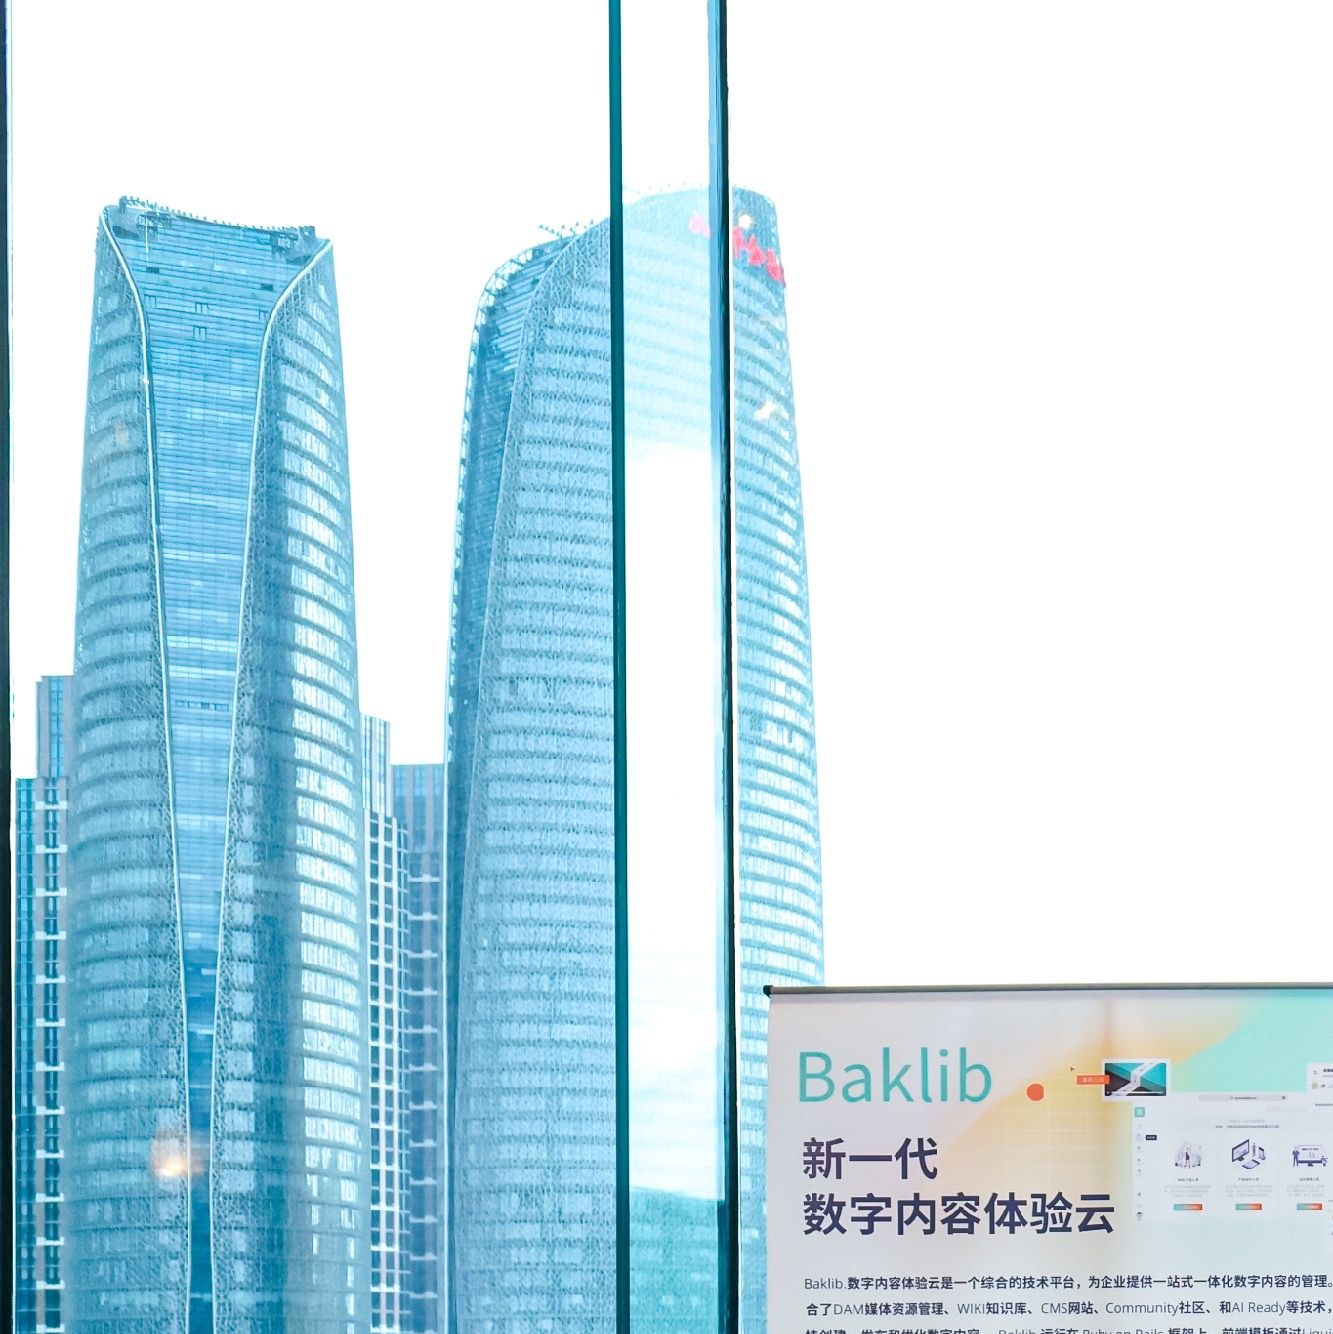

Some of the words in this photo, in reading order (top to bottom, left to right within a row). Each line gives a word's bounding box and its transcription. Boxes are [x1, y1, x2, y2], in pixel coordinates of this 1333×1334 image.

[798, 1046, 992, 1103] Baklib
[802, 1136, 939, 1181] 新一代
[802, 1191, 1117, 1237] 数字内容体验云
